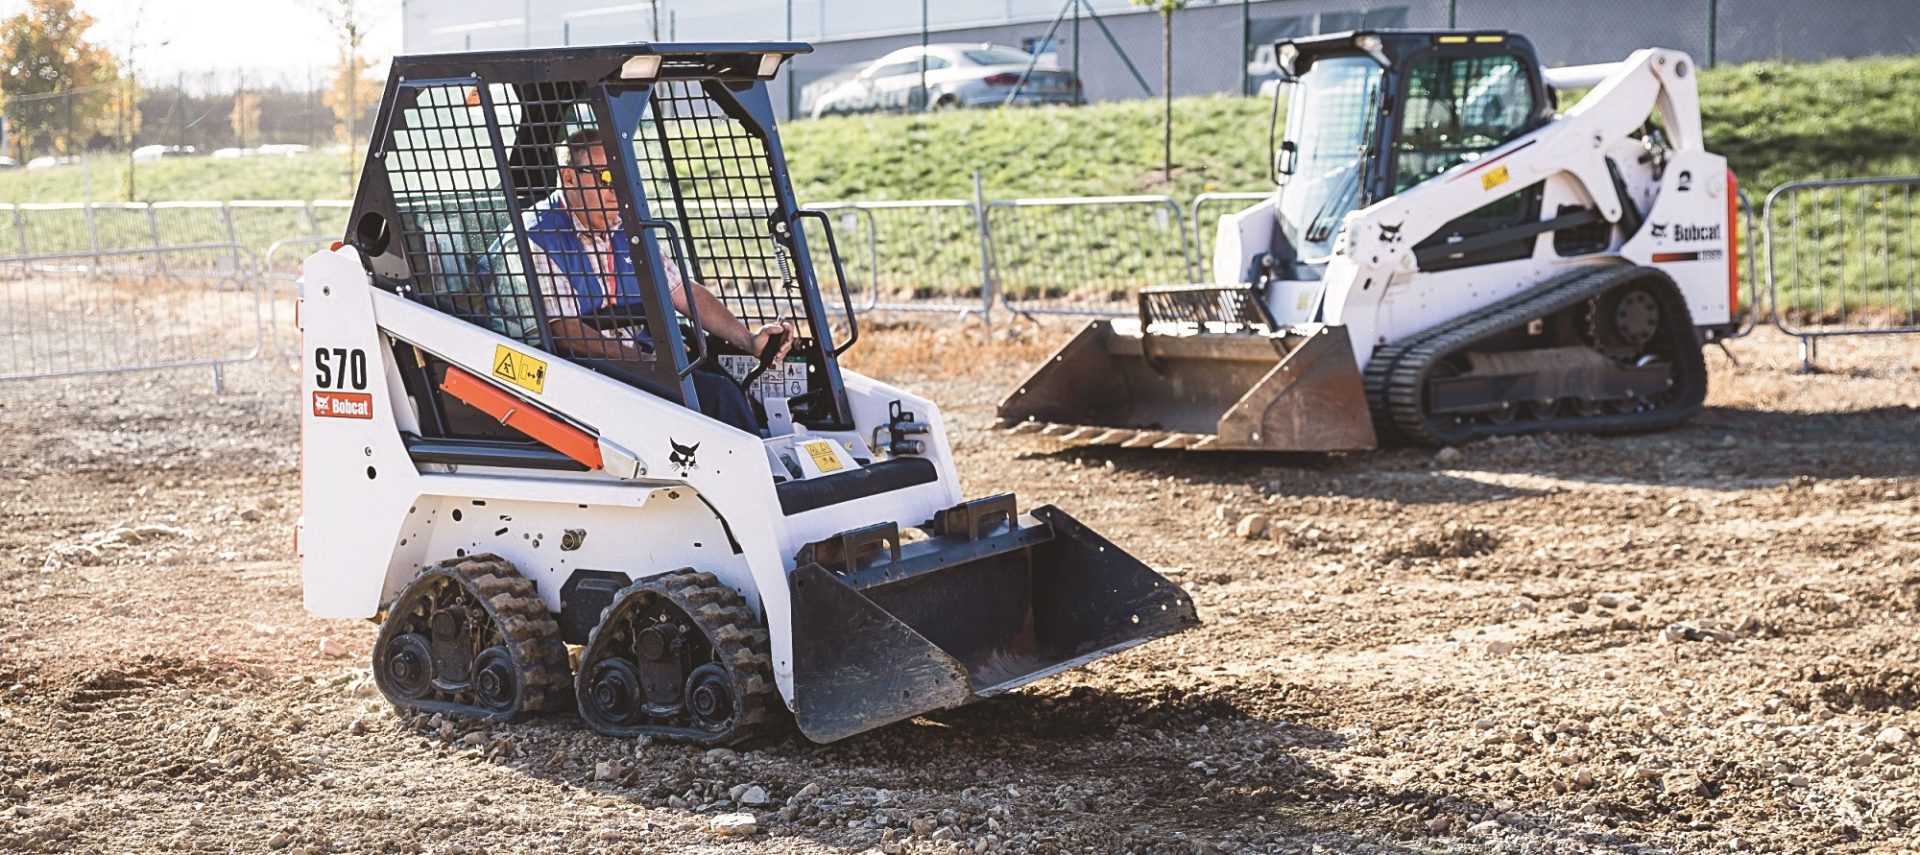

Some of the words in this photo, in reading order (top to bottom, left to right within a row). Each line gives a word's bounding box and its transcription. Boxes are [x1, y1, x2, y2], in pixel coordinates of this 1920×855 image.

[1674, 223, 1721, 241] Bobcat
[315, 347, 367, 390] S70
[332, 398, 368, 415] Bobcat
